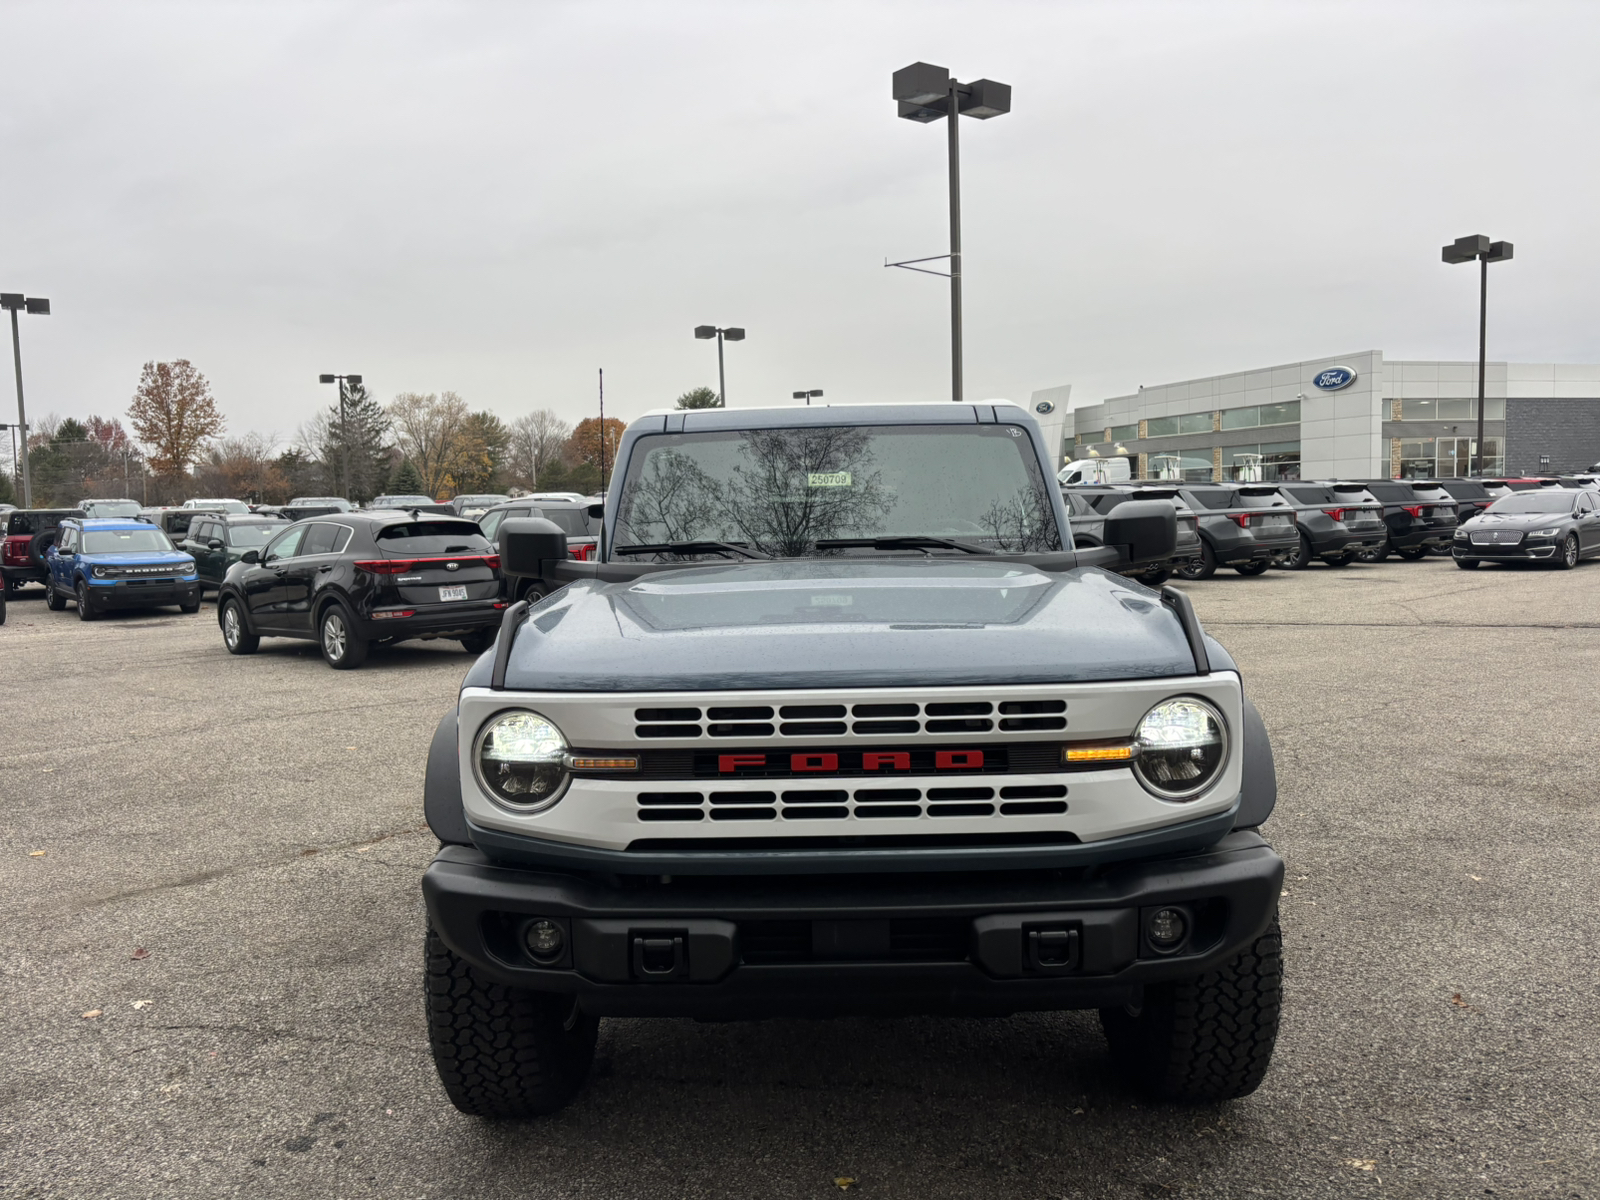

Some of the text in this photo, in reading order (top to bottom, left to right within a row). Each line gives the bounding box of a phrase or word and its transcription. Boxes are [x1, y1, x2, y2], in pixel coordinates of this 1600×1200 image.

[1319, 371, 1344, 387] Ford
[811, 475, 847, 485] 250709
[718, 750, 984, 772] FORD
